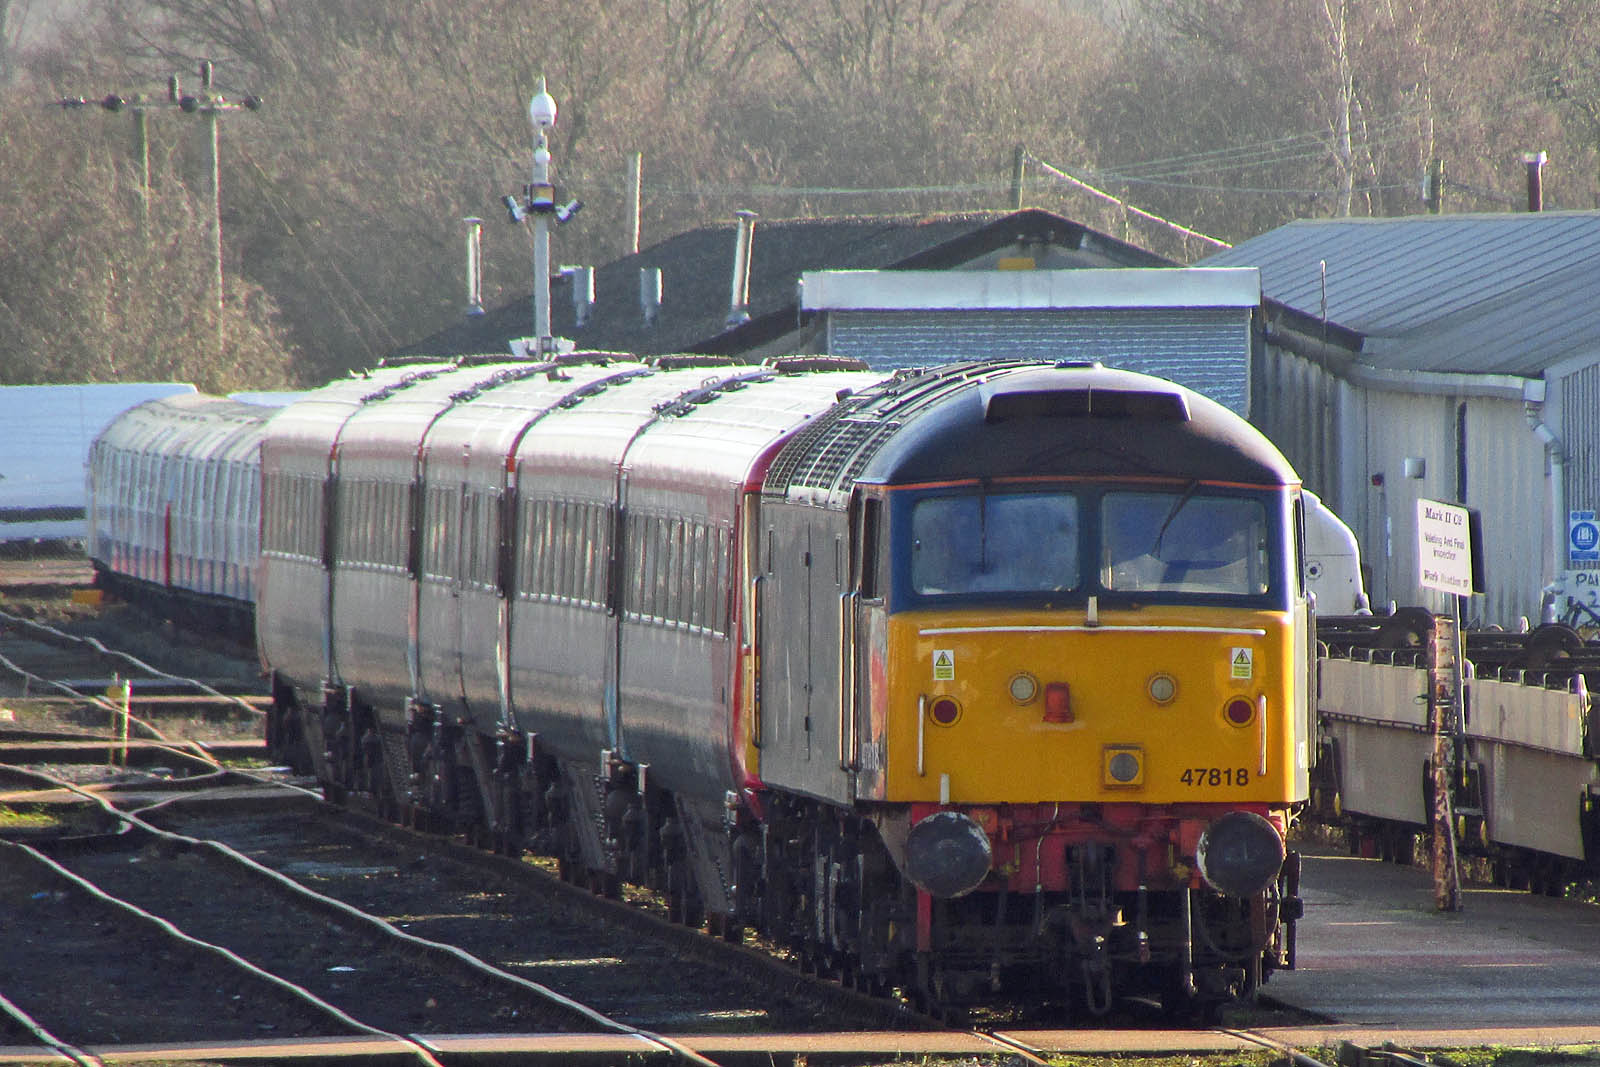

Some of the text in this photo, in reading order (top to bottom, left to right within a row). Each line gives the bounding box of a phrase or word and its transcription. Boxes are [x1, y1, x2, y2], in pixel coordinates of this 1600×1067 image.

[1425, 507, 1443, 523] Mark
[1424, 569, 1439, 583] Work
[1180, 767, 1249, 787] 47818
